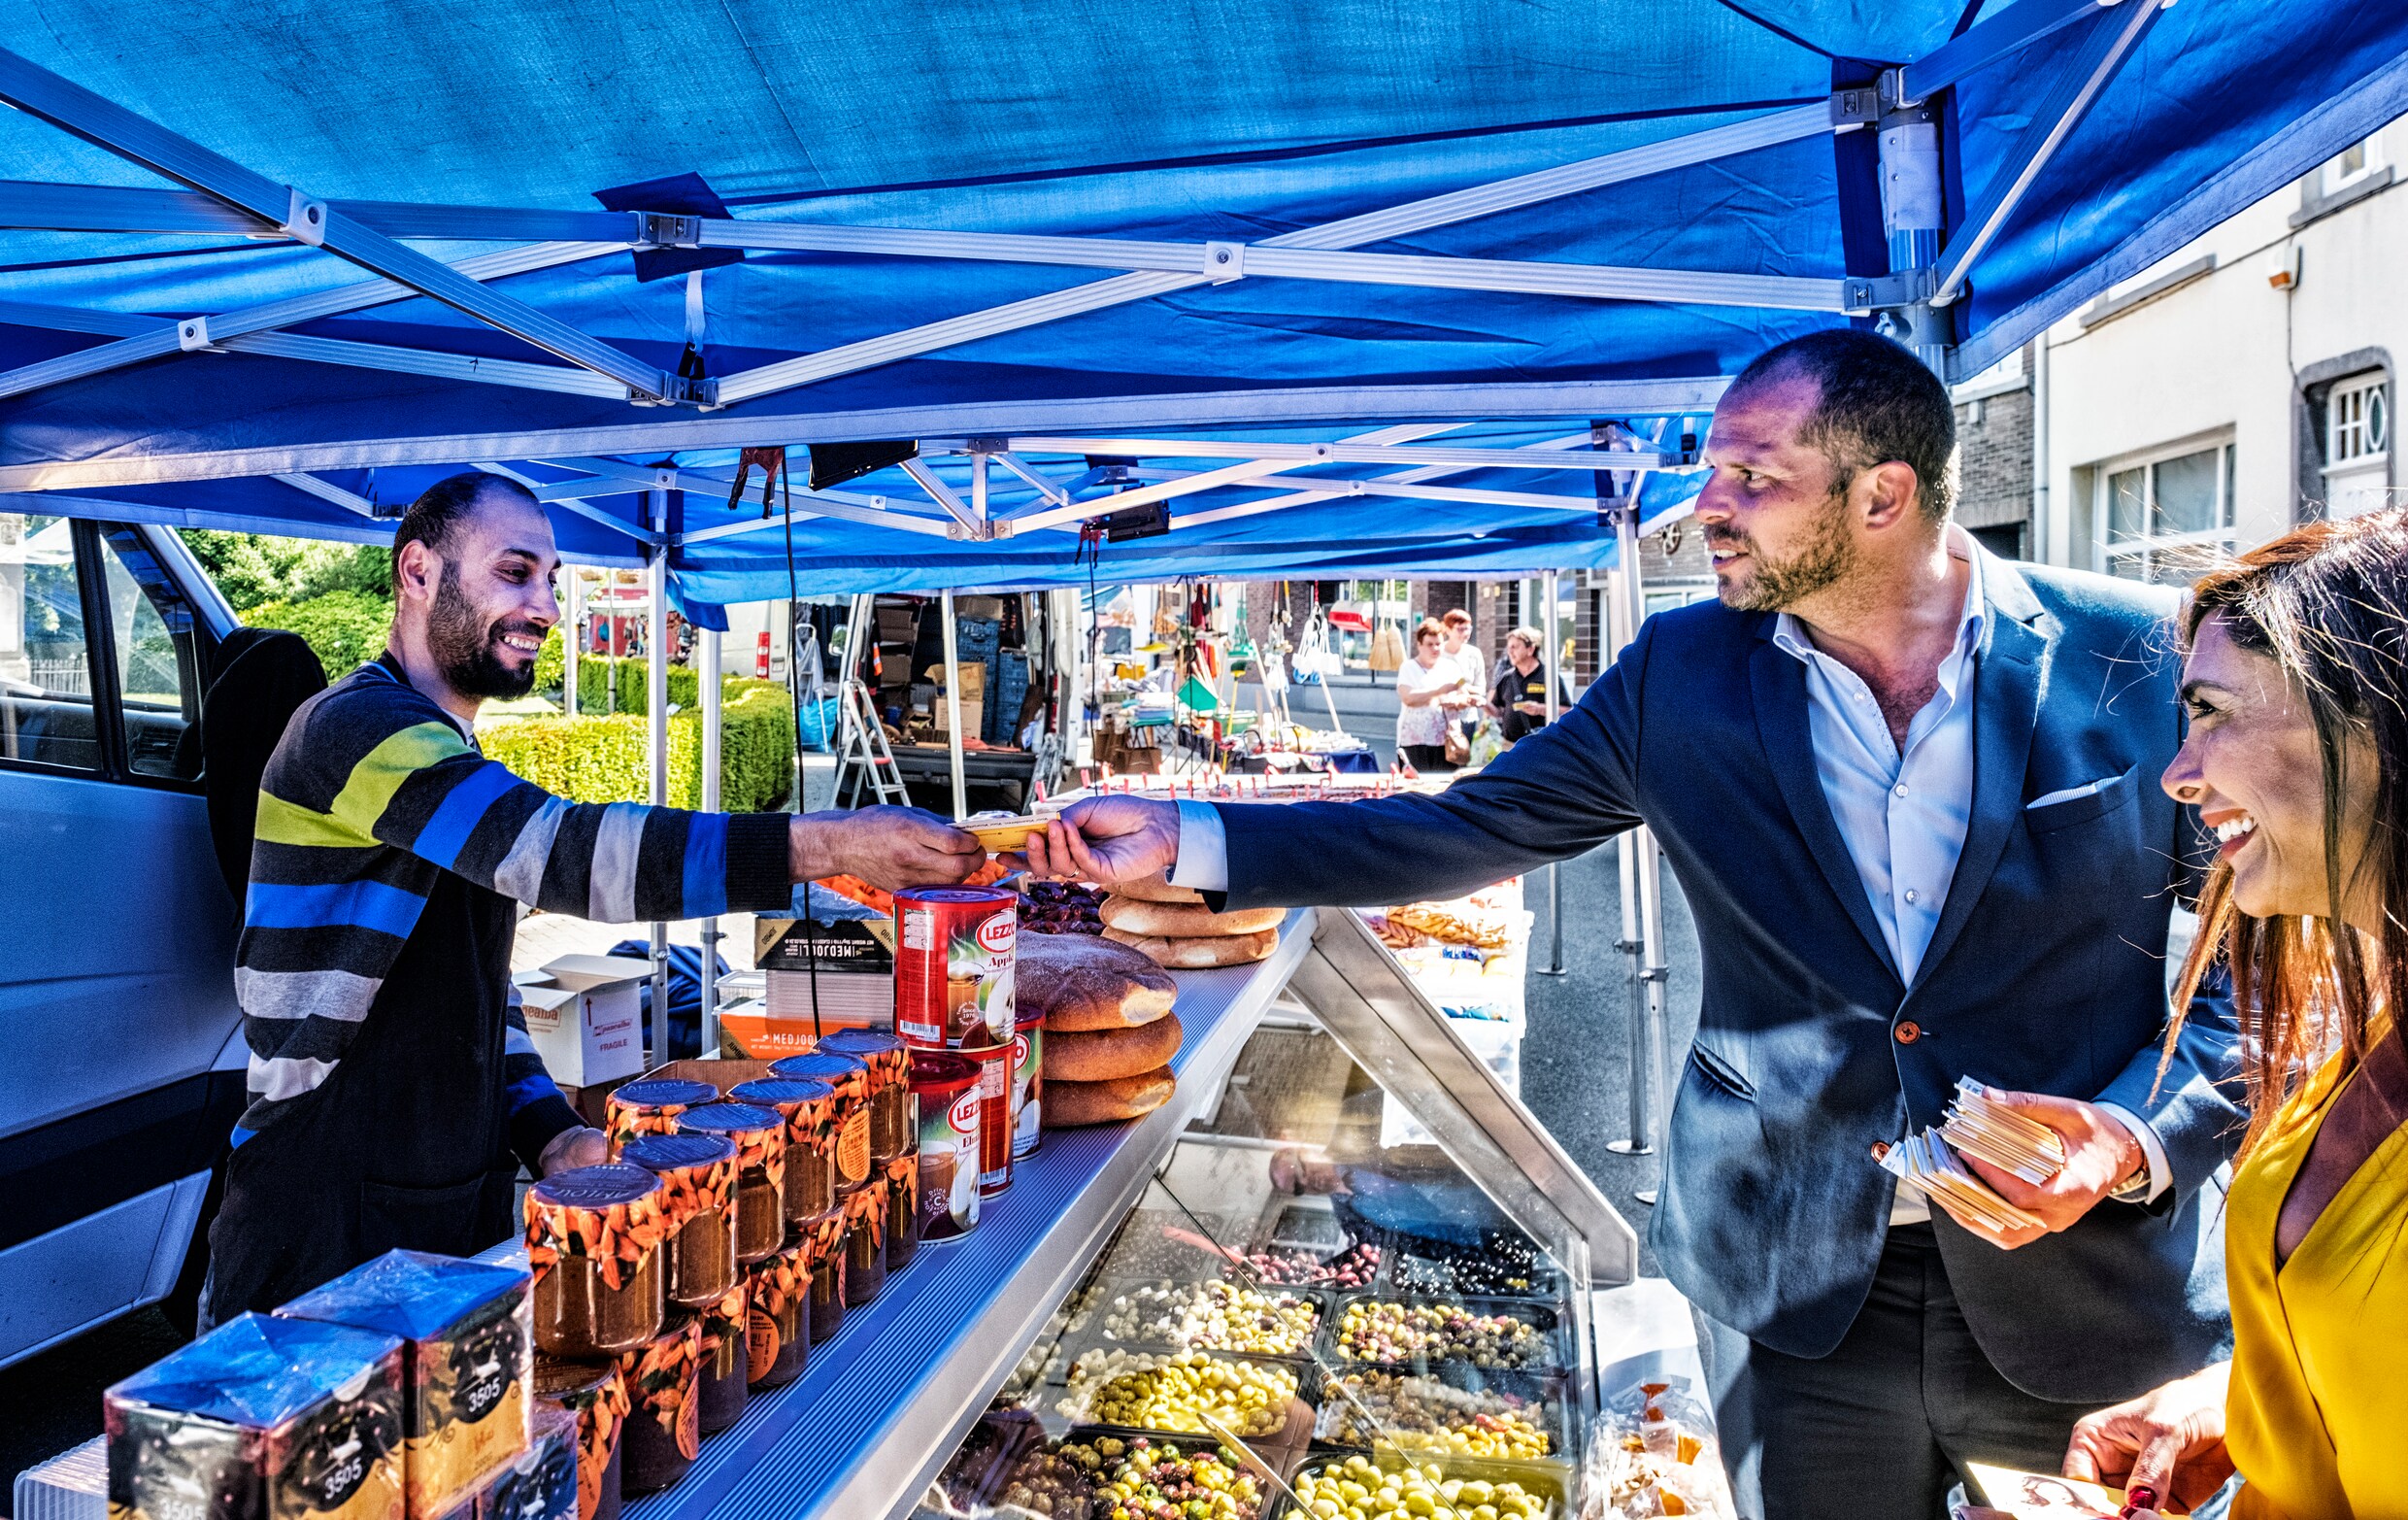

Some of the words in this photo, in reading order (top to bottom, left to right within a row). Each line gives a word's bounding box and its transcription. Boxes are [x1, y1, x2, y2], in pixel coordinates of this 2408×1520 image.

[600, 1038, 628, 1051] FRAGILE
[727, 1041, 746, 1060] JUMBO
[626, 1080, 685, 1092] AMLOU
[933, 1196, 942, 1206] C
[468, 1375, 502, 1413] 3505
[324, 1457, 364, 1501] 3505
